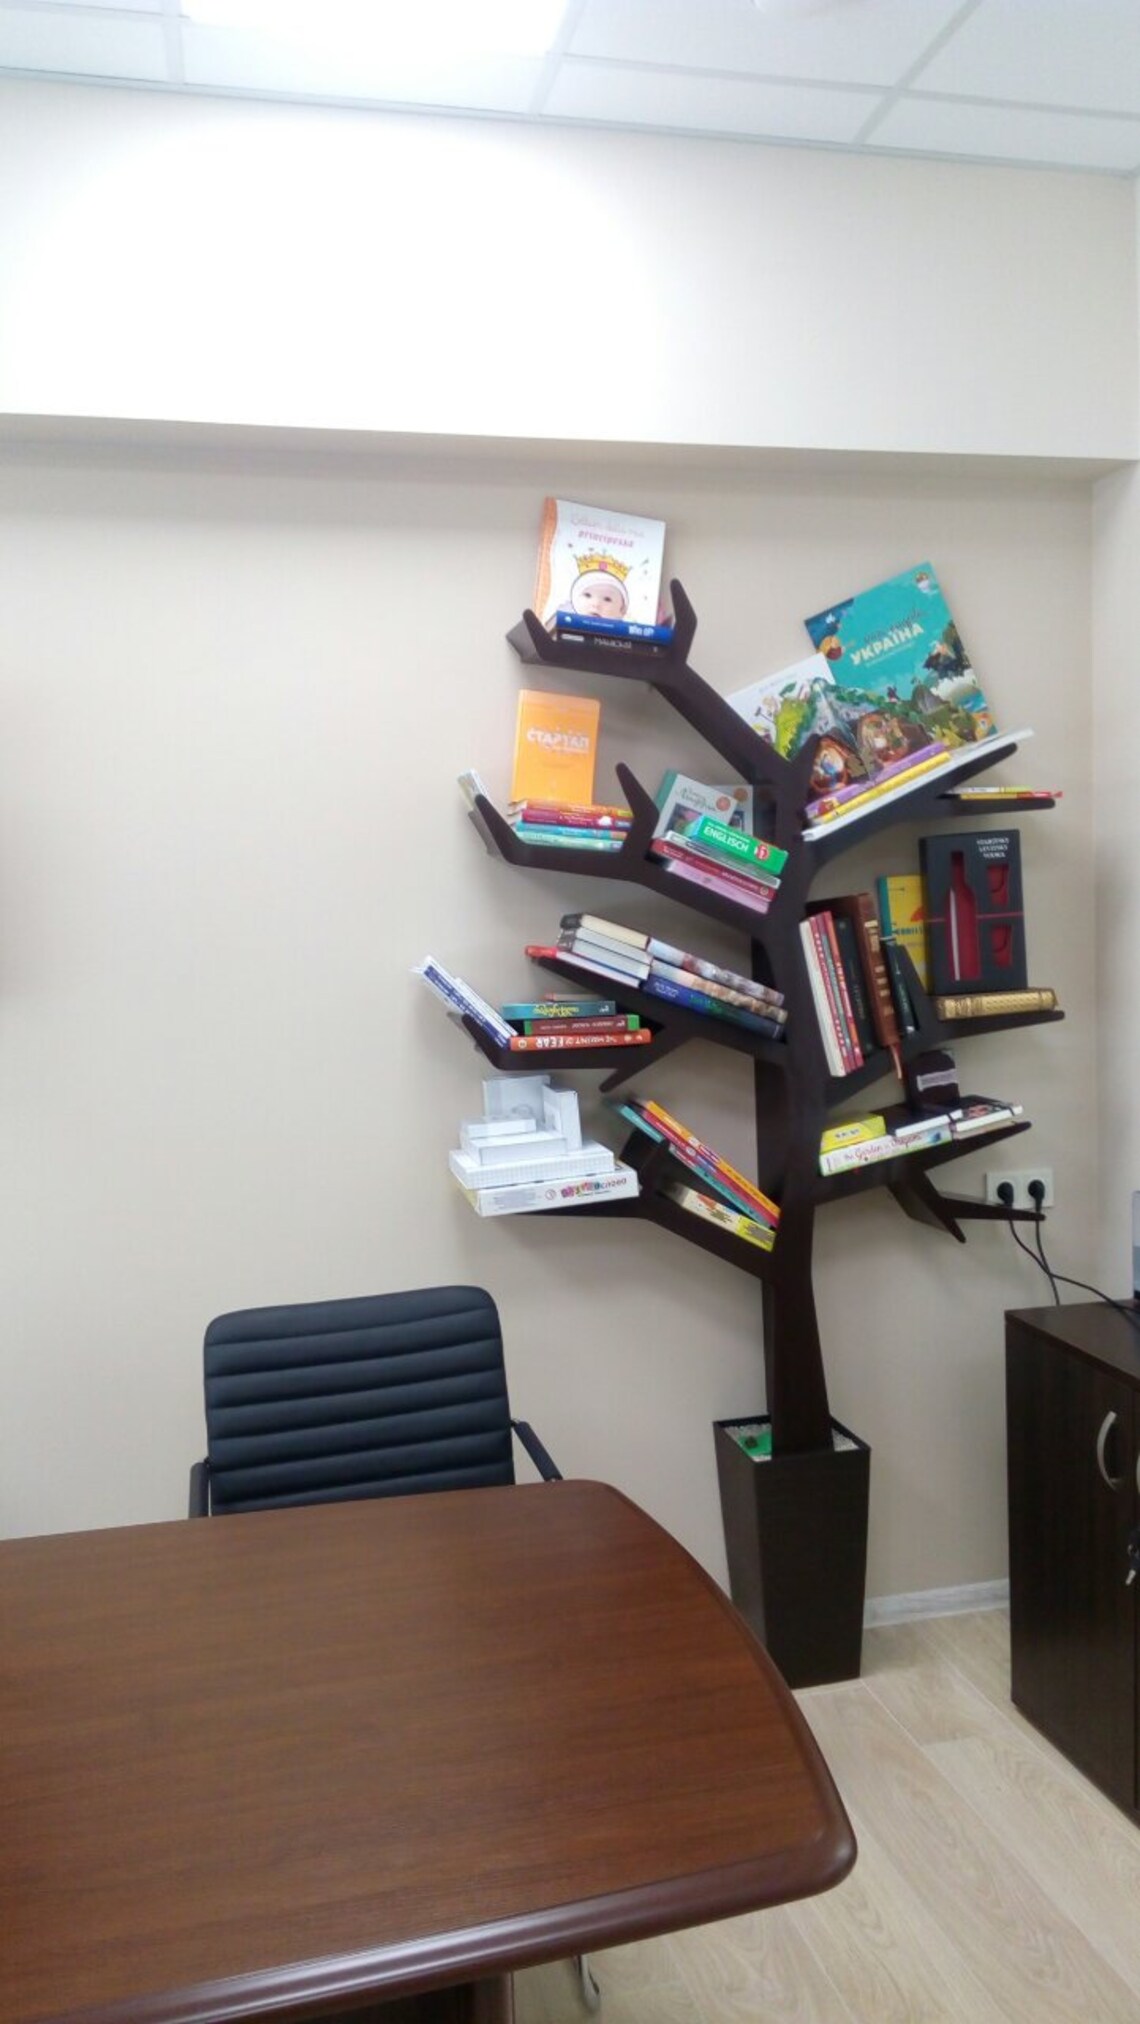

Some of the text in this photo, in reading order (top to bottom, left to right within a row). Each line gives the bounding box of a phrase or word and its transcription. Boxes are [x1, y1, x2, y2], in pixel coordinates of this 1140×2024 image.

[849, 622, 925, 666] УКРАЇНА
[703, 826, 749, 852] ENGLISCH
[535, 1036, 564, 1048] FEAR
